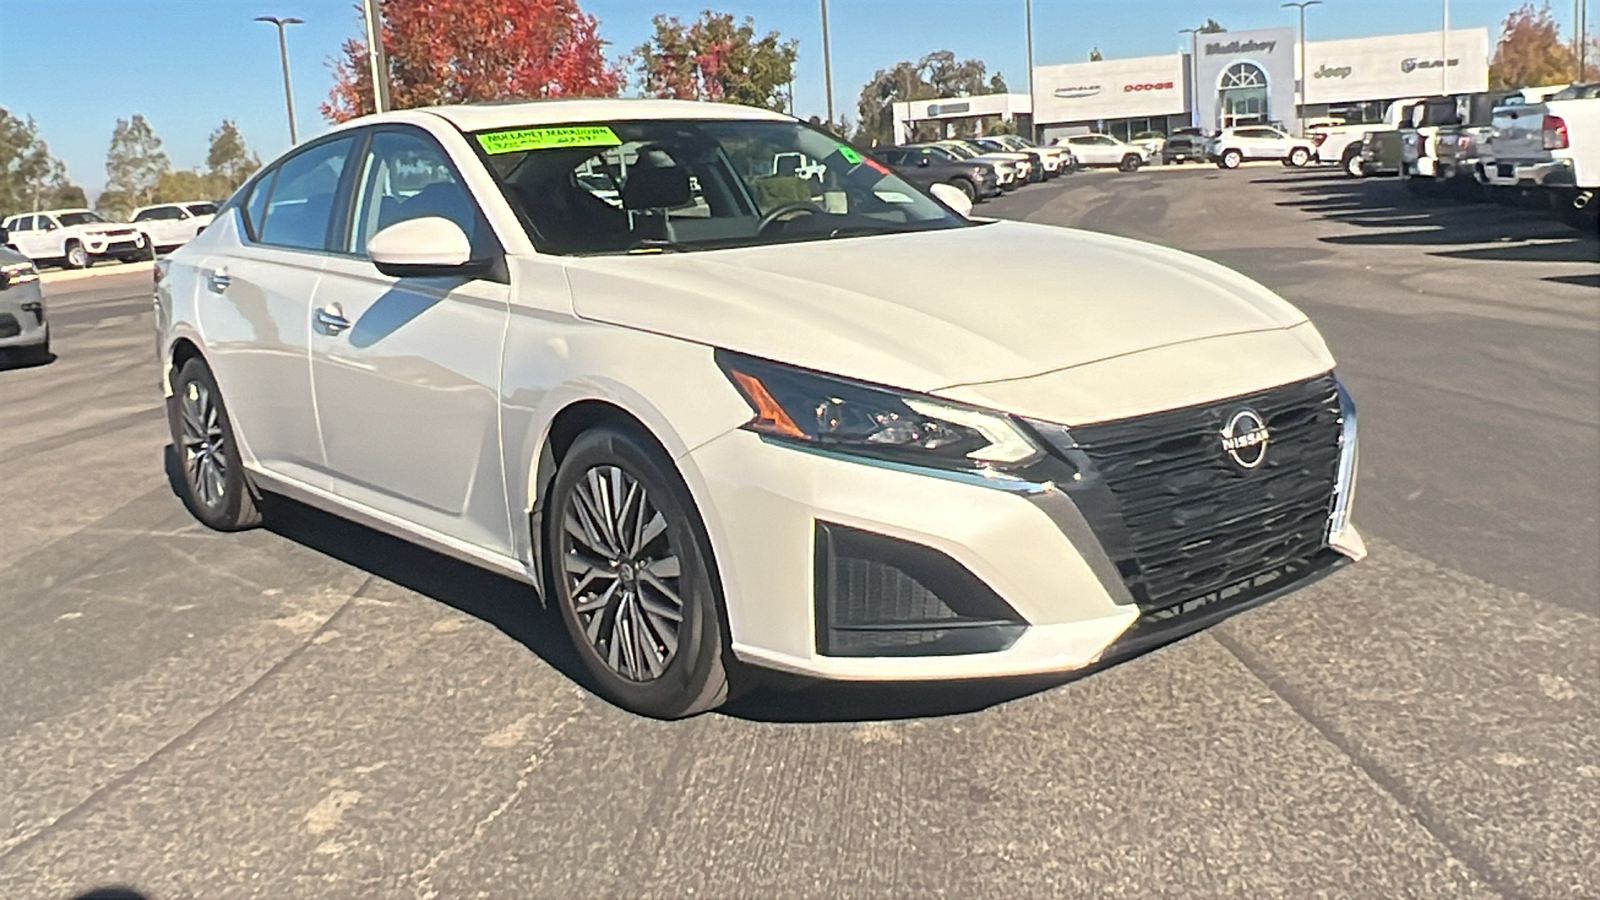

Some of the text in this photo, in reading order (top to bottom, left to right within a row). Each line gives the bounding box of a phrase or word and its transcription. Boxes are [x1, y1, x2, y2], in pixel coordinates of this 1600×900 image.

[1313, 65, 1352, 79] Jeep
[1124, 82, 1173, 92] DODGE
[1221, 429, 1269, 450] NISSAN
